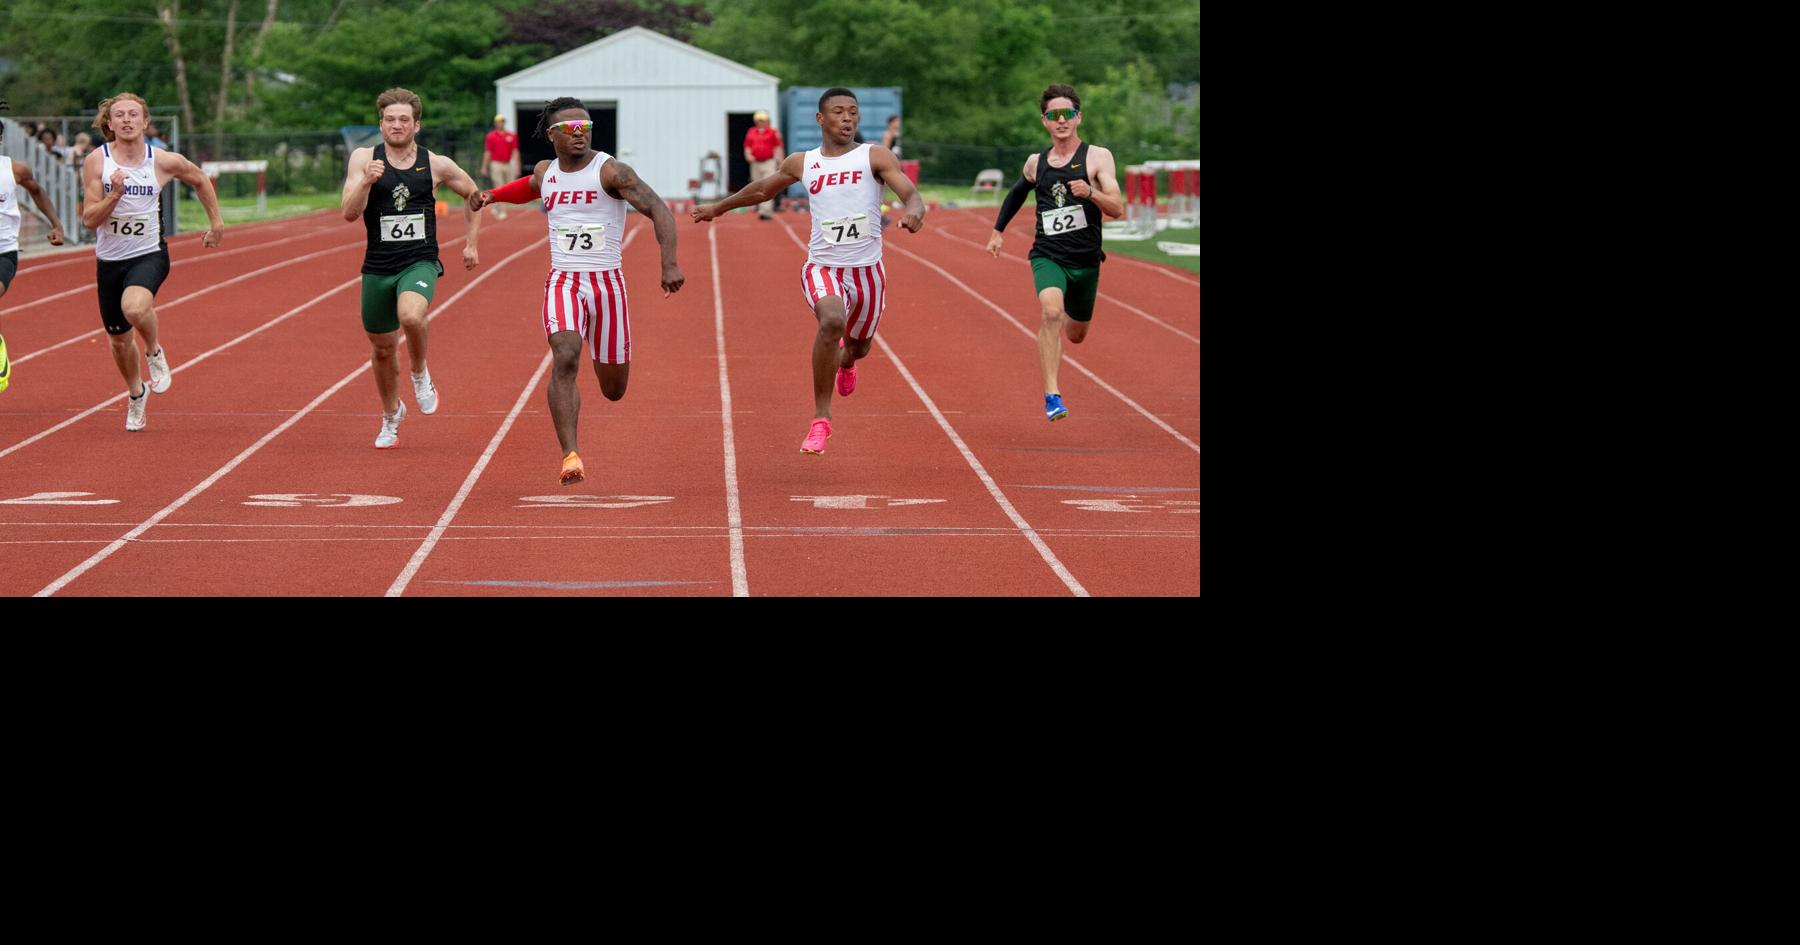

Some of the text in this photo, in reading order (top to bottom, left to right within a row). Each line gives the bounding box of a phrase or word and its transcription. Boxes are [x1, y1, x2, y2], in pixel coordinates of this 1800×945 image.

[104, 183, 153, 196] SMOUR
[809, 171, 862, 194] JEFF
[544, 190, 598, 211] JEFF
[110, 220, 145, 236] 162
[391, 223, 416, 239] 64
[1052, 214, 1077, 232] 62
[831, 223, 860, 242] 74
[565, 233, 593, 250] 73
